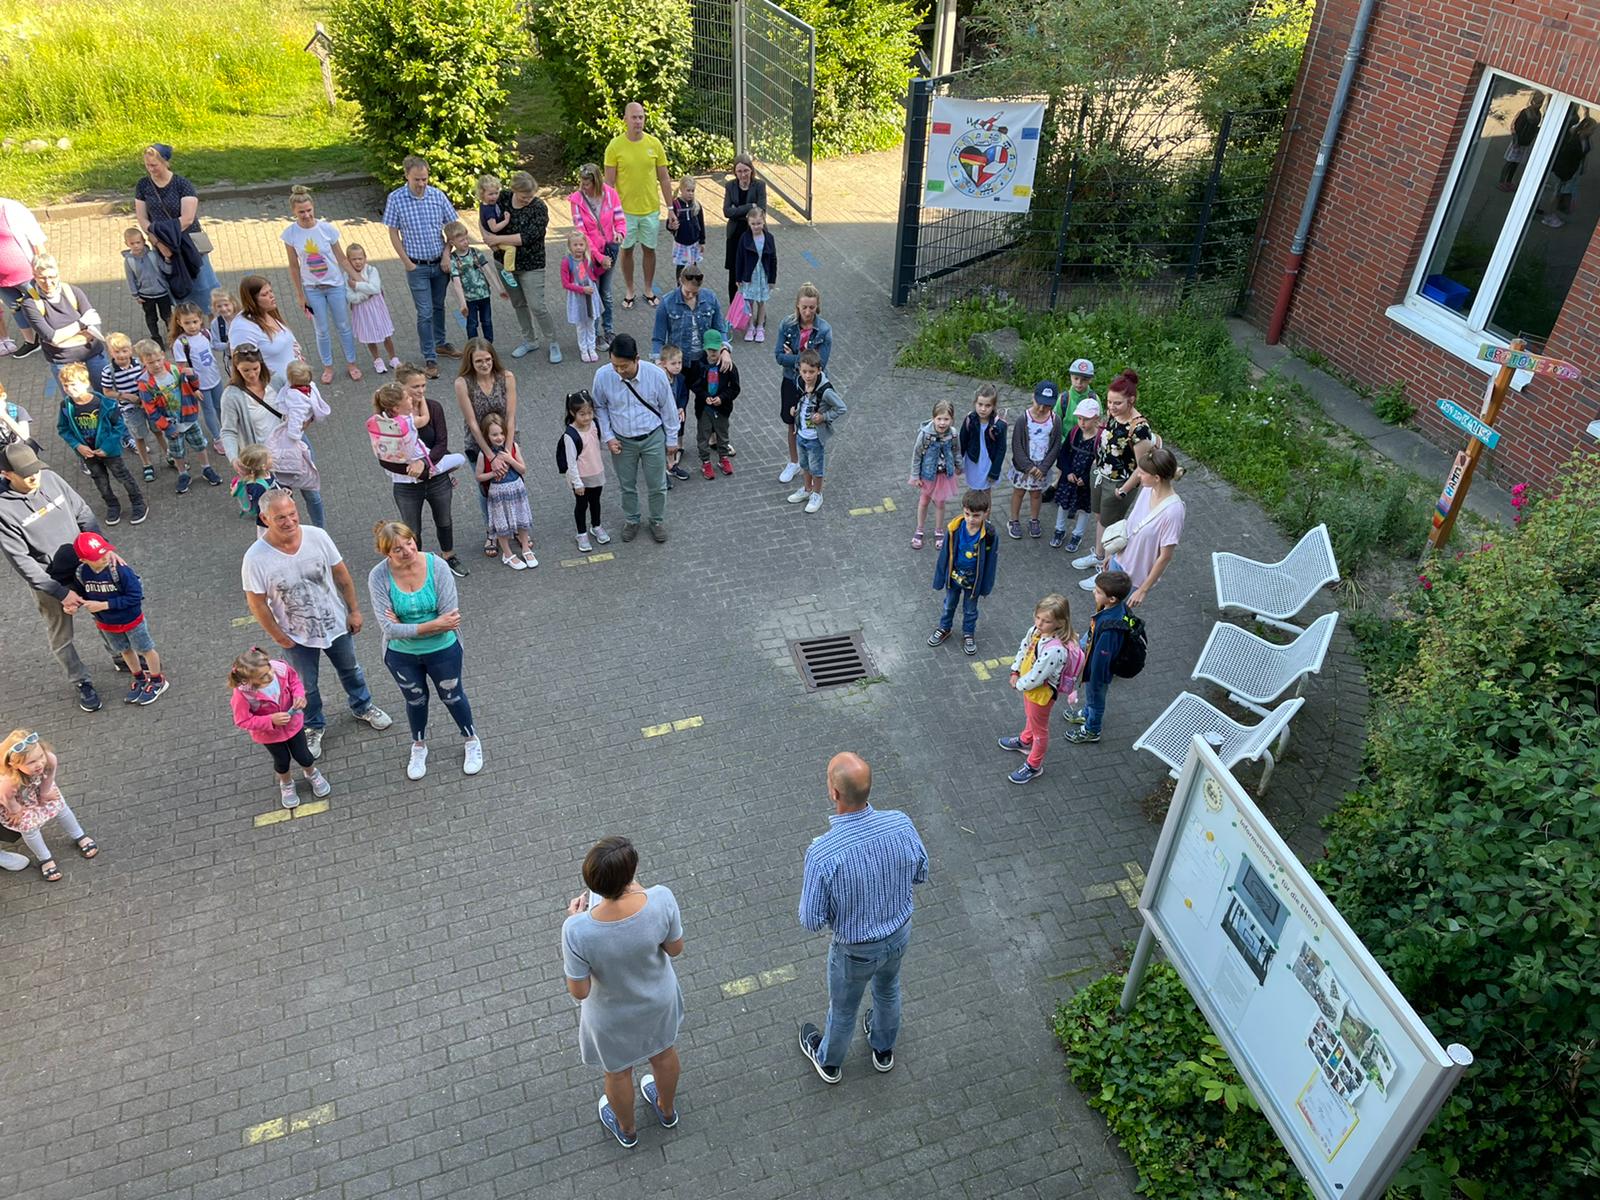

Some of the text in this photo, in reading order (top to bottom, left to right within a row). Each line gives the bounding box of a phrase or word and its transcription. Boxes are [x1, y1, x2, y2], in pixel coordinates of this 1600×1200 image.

[1239, 818, 1319, 928] Informationen für die Eltern
